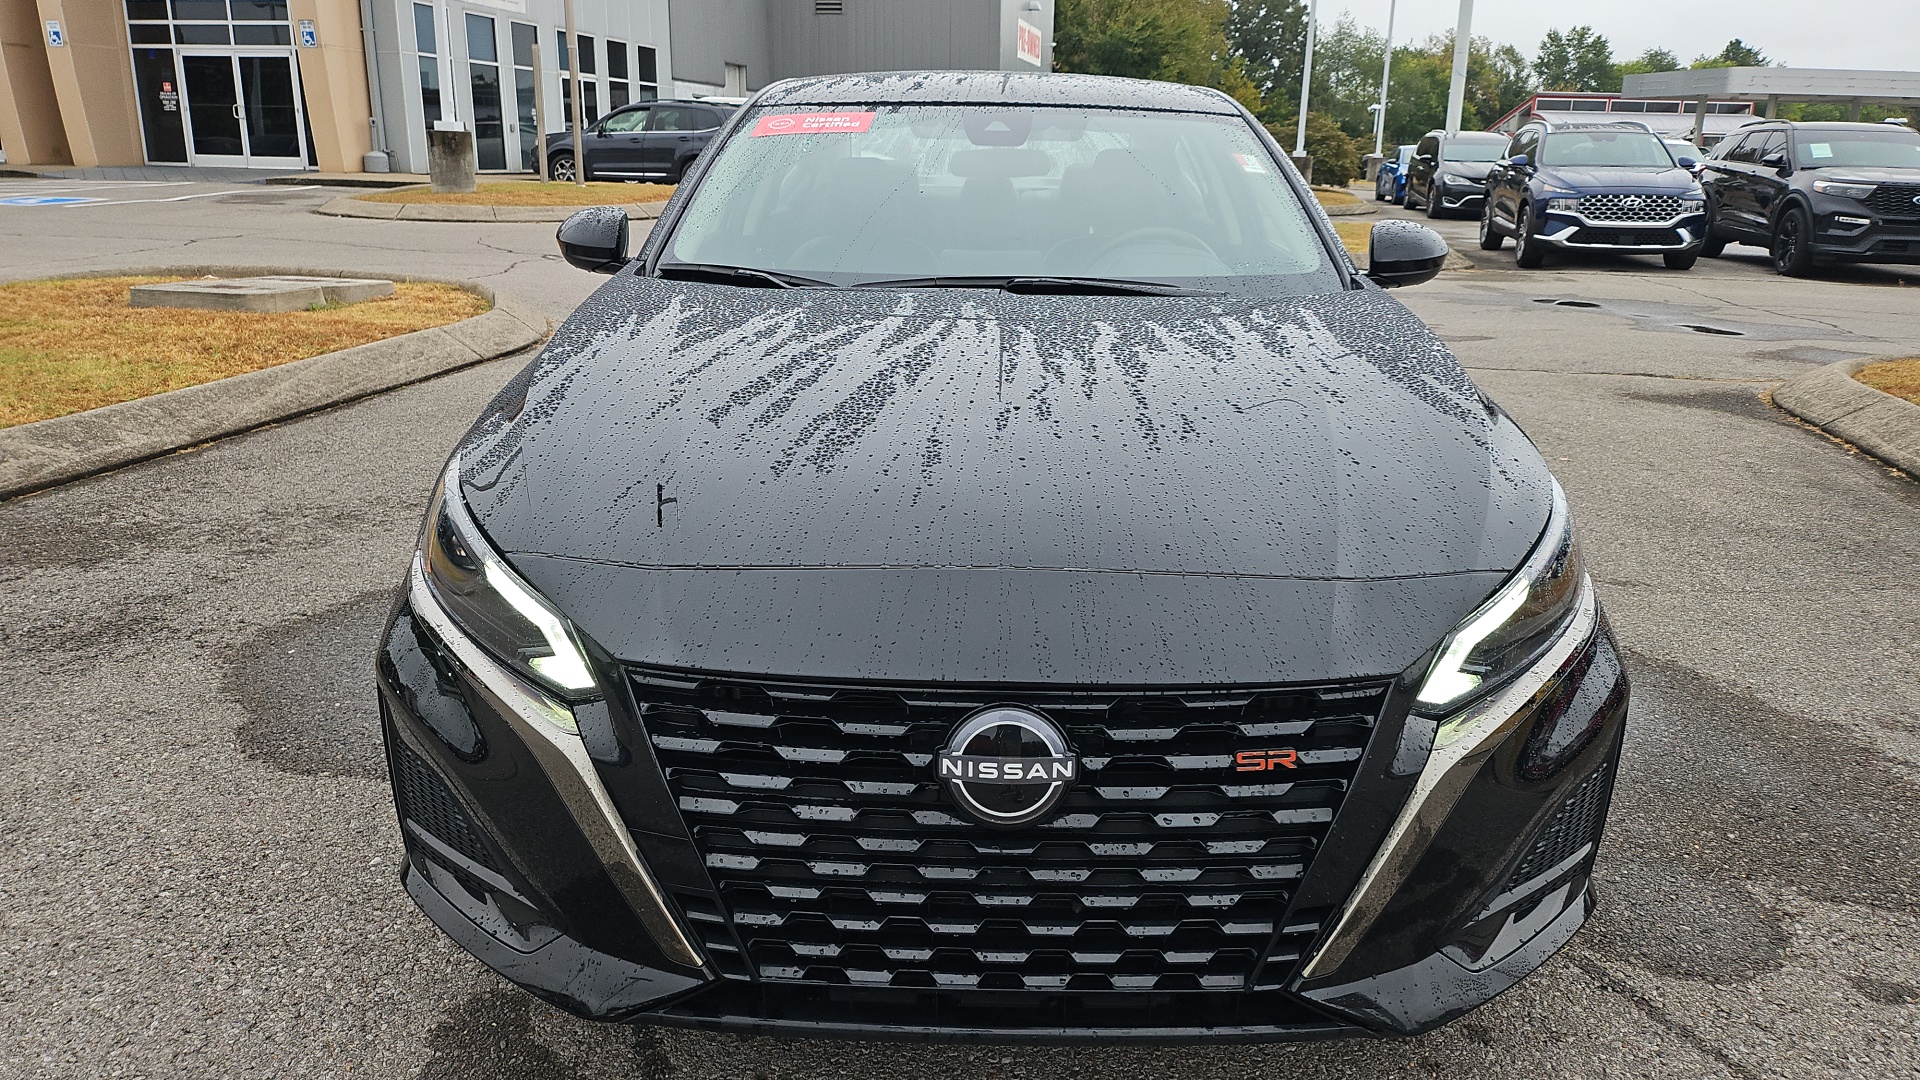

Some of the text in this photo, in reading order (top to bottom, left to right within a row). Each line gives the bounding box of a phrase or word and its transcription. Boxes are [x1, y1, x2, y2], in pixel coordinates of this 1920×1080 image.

[1018, 25, 1040, 59] PRE-OWNED
[942, 758, 1072, 779] NISSAN
[1236, 749, 1298, 771] SR
